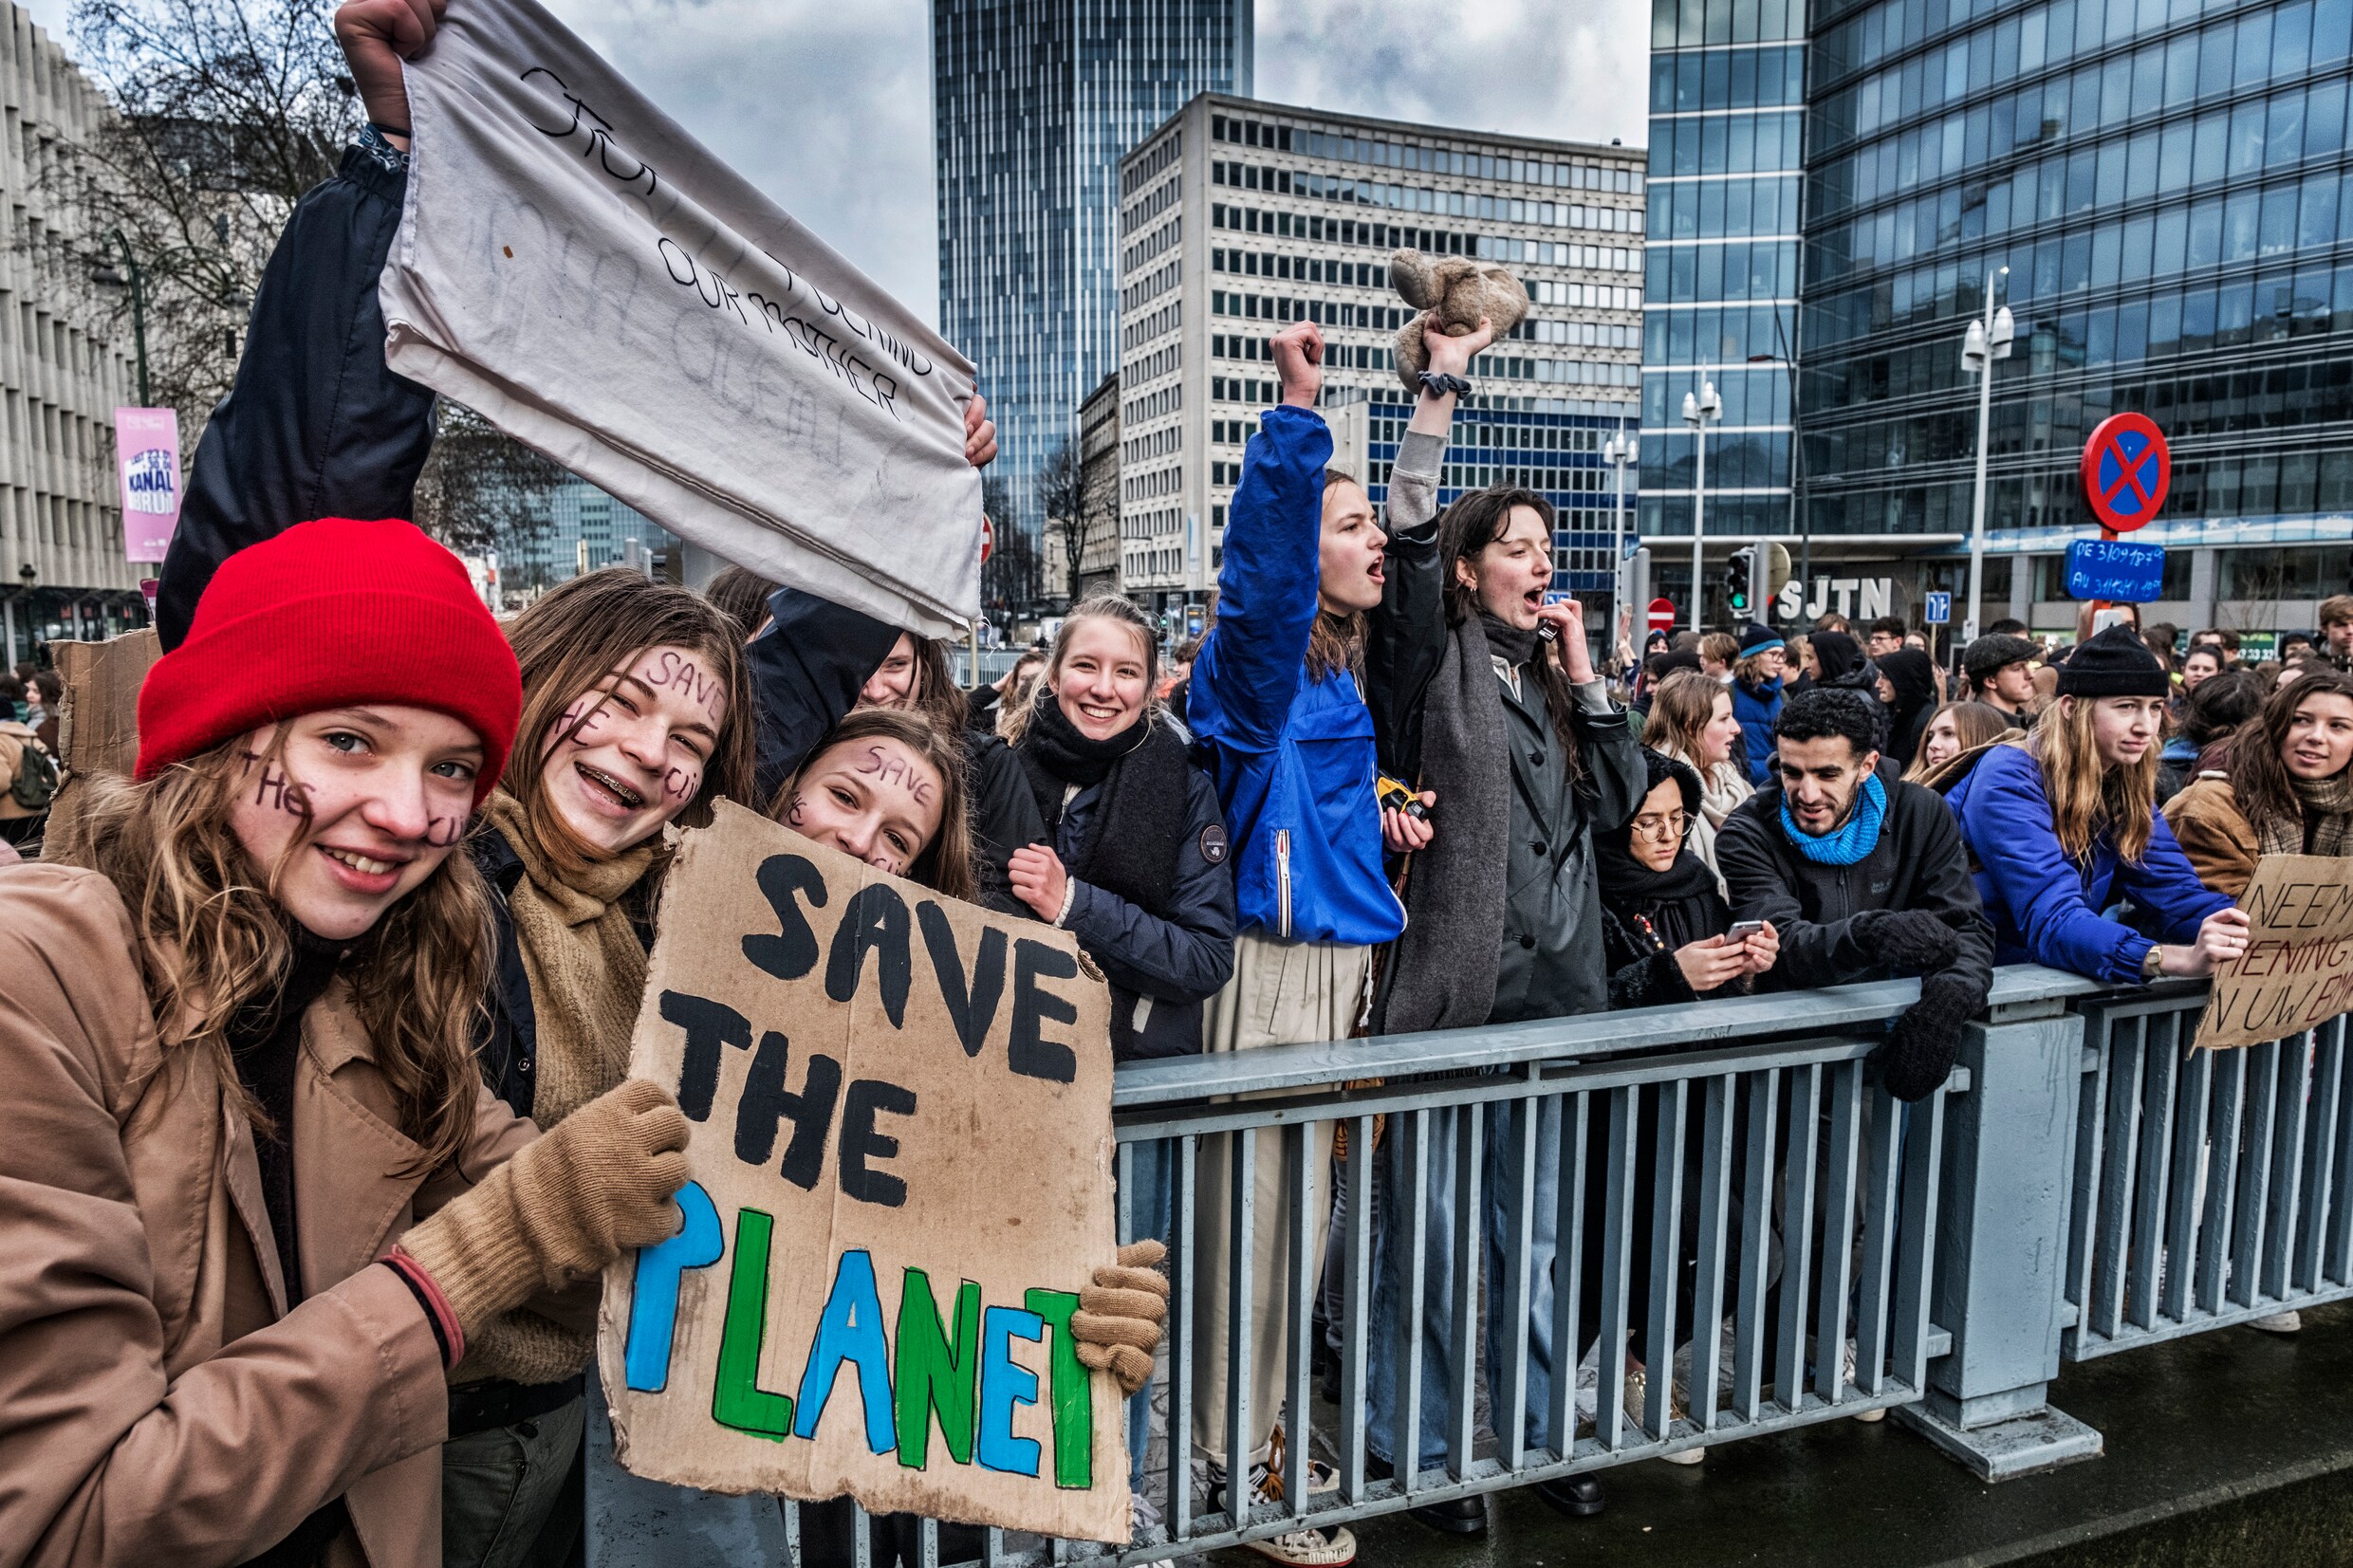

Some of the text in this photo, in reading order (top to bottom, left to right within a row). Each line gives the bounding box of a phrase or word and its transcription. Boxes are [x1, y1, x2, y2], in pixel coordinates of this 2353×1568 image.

[658, 237, 748, 325] OUR
[129, 470, 175, 491] KANAL
[1777, 577, 1892, 619] SJTN
[646, 651, 727, 721] SAVE
[855, 746, 934, 807] SAVE
[740, 854, 1079, 1083] SAVE
[2244, 981, 2318, 1031] UW
[658, 988, 917, 1208] THE
[624, 1179, 1095, 1490] PLANET
